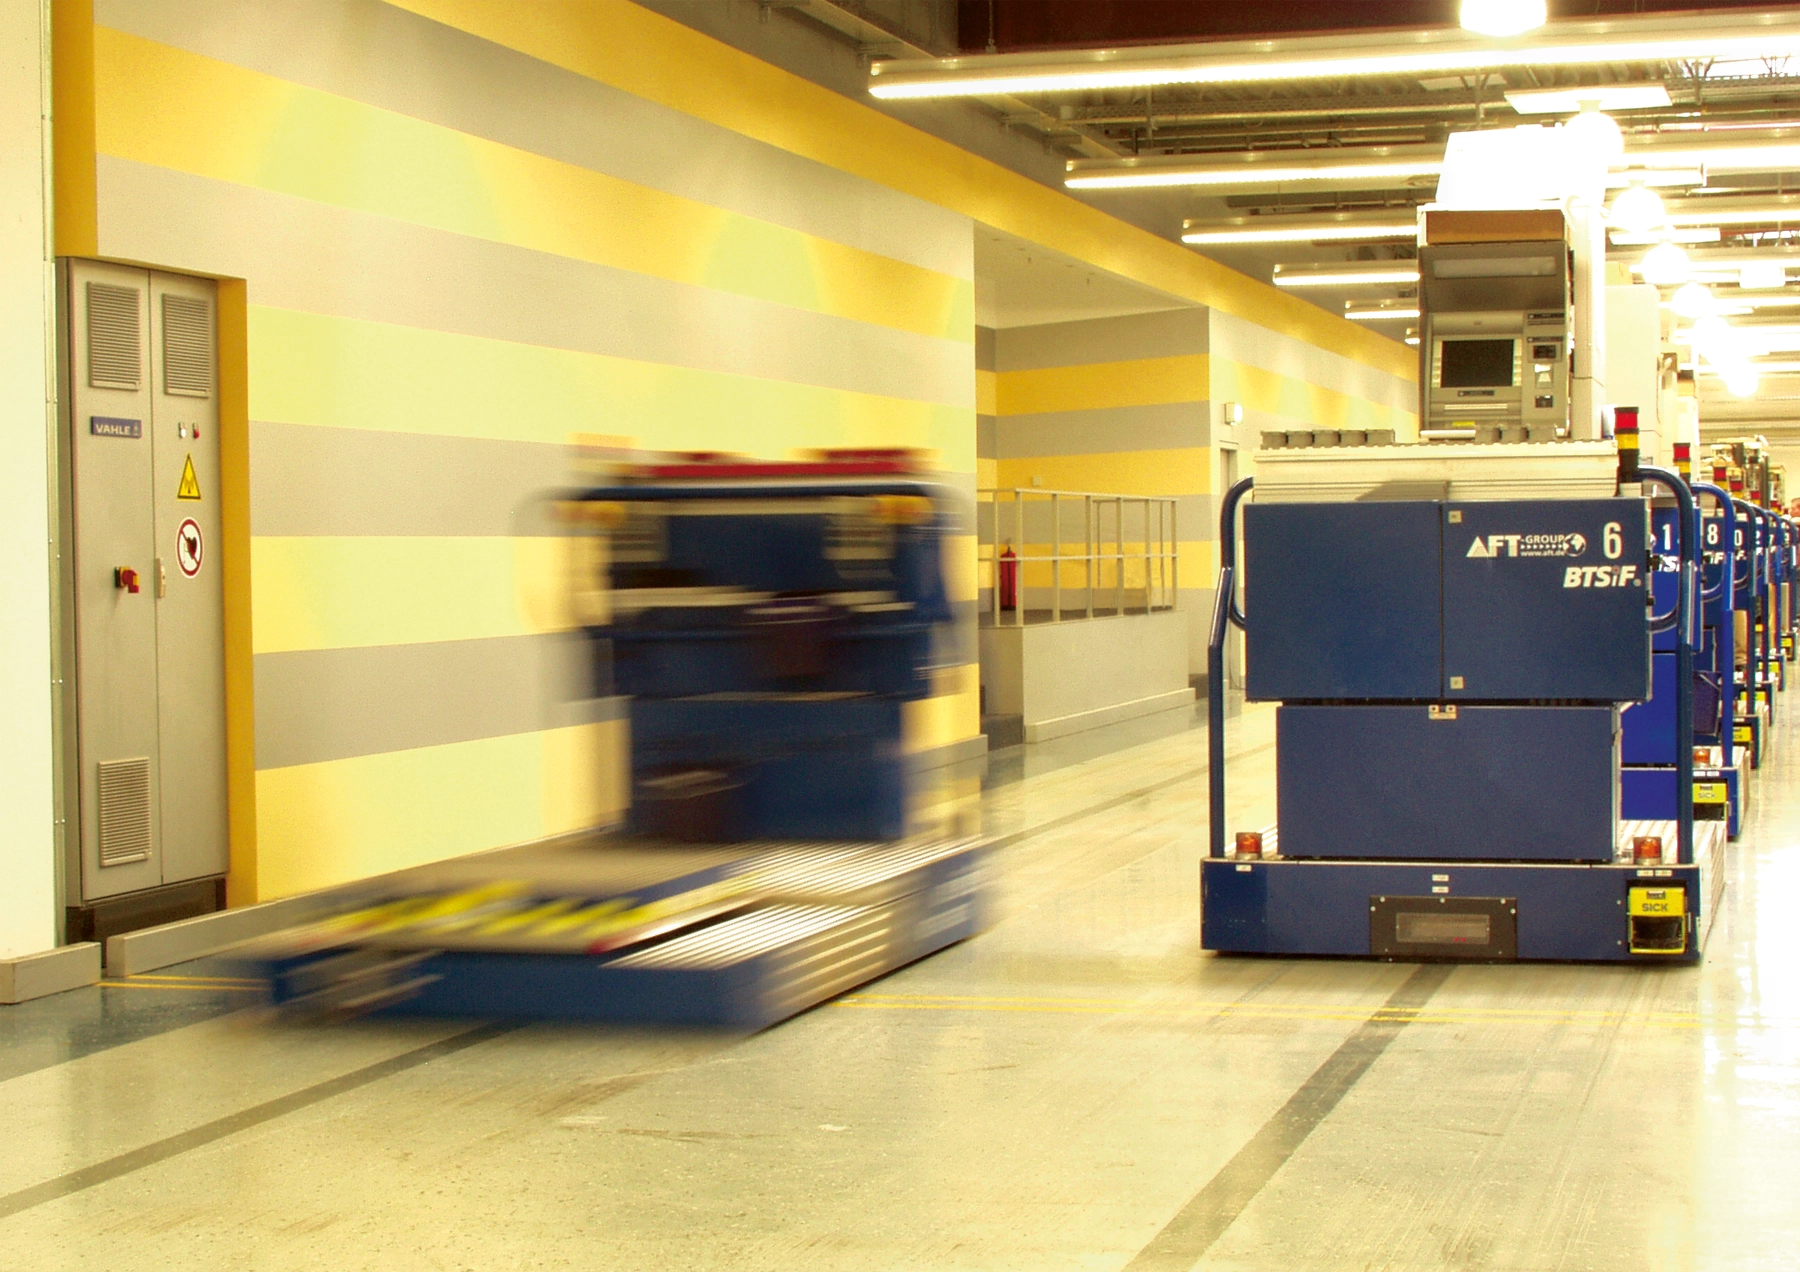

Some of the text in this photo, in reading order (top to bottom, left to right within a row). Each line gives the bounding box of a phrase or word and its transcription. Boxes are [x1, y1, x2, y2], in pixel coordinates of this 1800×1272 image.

[96, 423, 130, 435] VAHLE
[1603, 521, 1622, 560] 6
[1662, 523, 1671, 550] 1
[1707, 523, 1719, 545] 8
[1641, 902, 1668, 912] SICK
